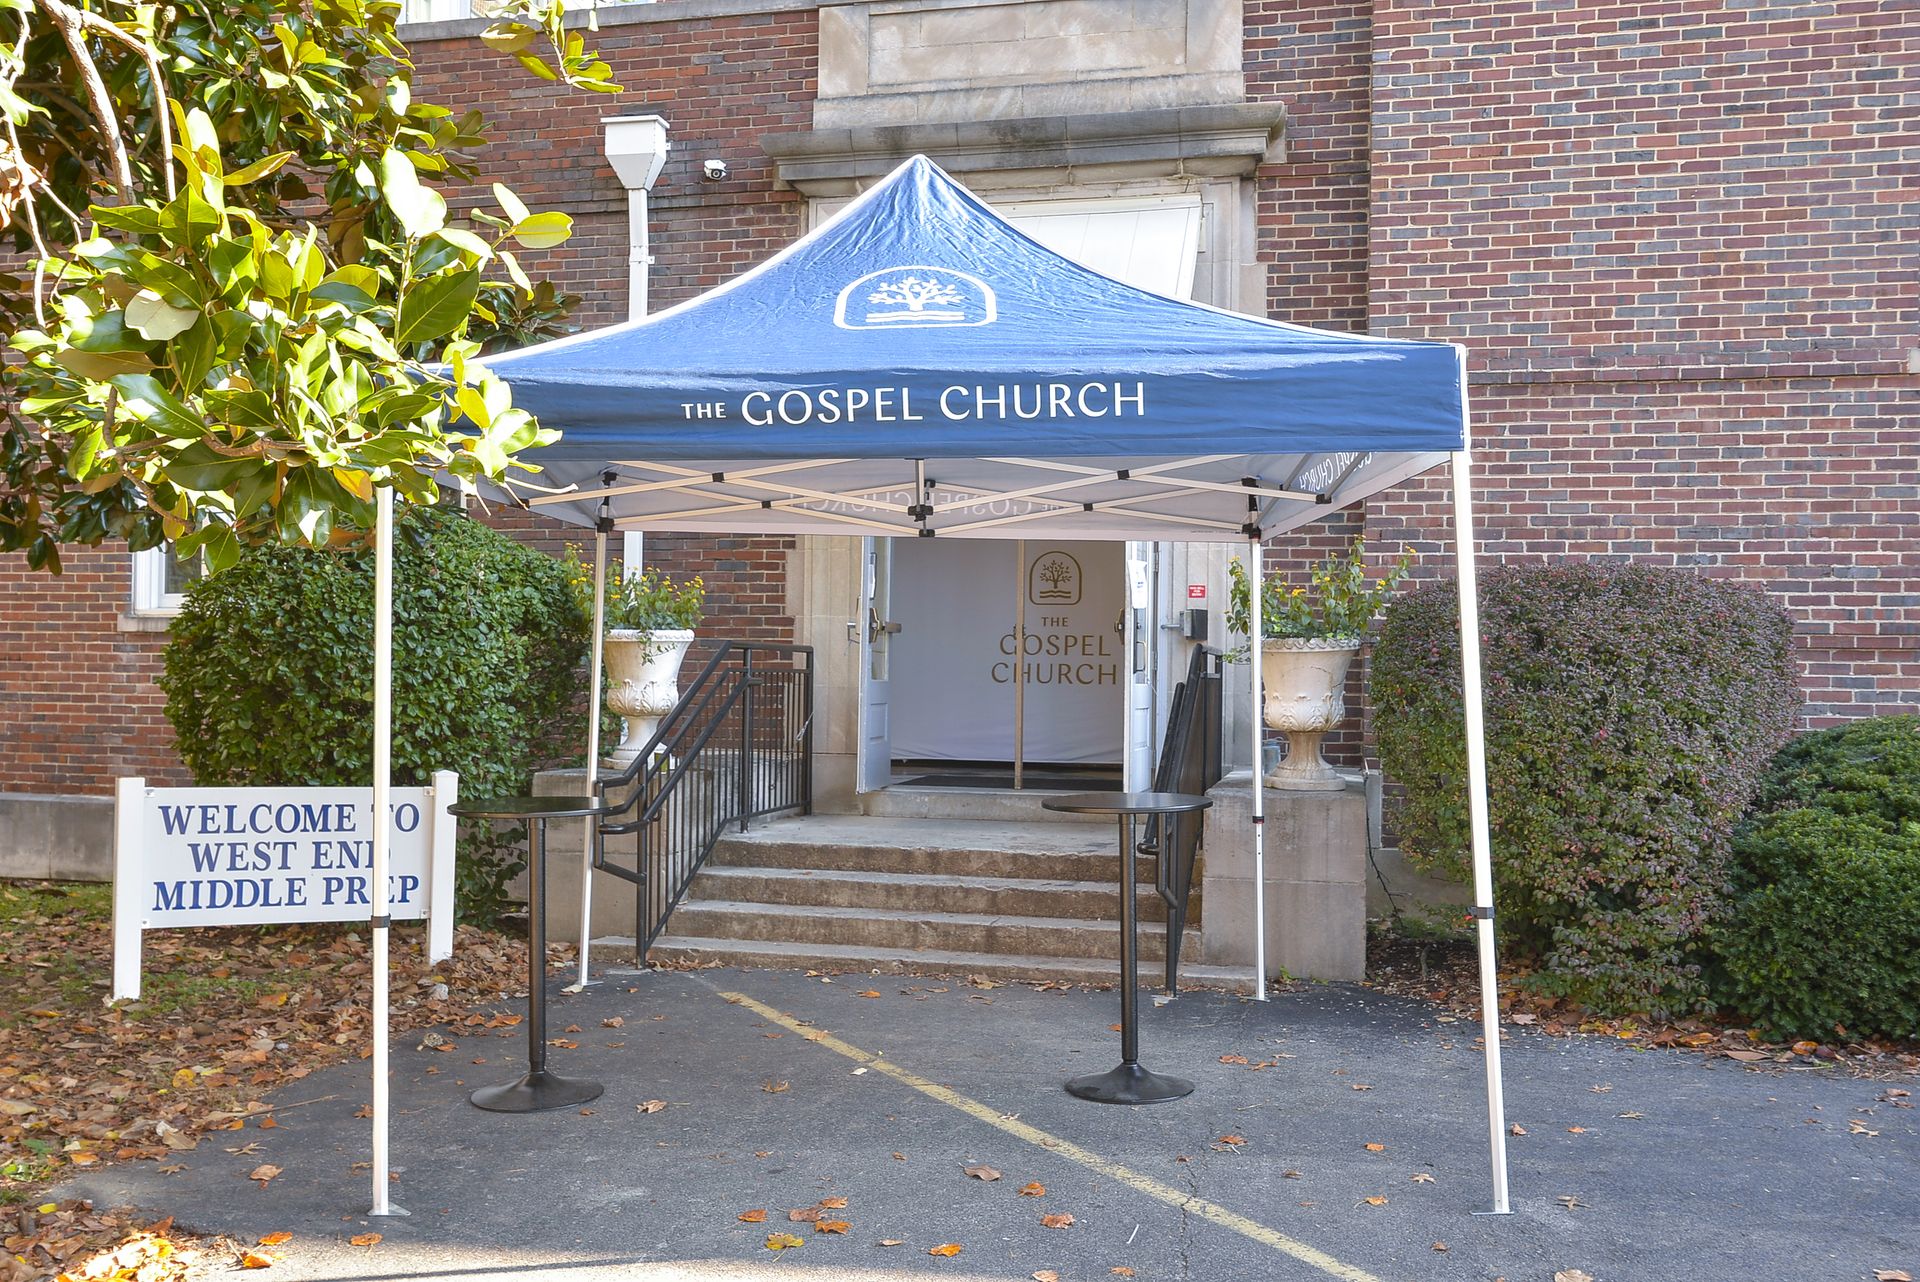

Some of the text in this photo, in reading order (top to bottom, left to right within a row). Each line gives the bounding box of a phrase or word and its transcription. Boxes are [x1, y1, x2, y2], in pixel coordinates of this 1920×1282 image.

[680, 381, 1146, 426] THE GOSPEL CHURCH
[1041, 616, 1070, 628] THE
[1000, 633, 1112, 657] GOSPEL
[991, 662, 1117, 686] CHURCH
[157, 803, 357, 836] WELCOME
[187, 840, 298, 873] WEST
[152, 877, 308, 911] MIDDLE
